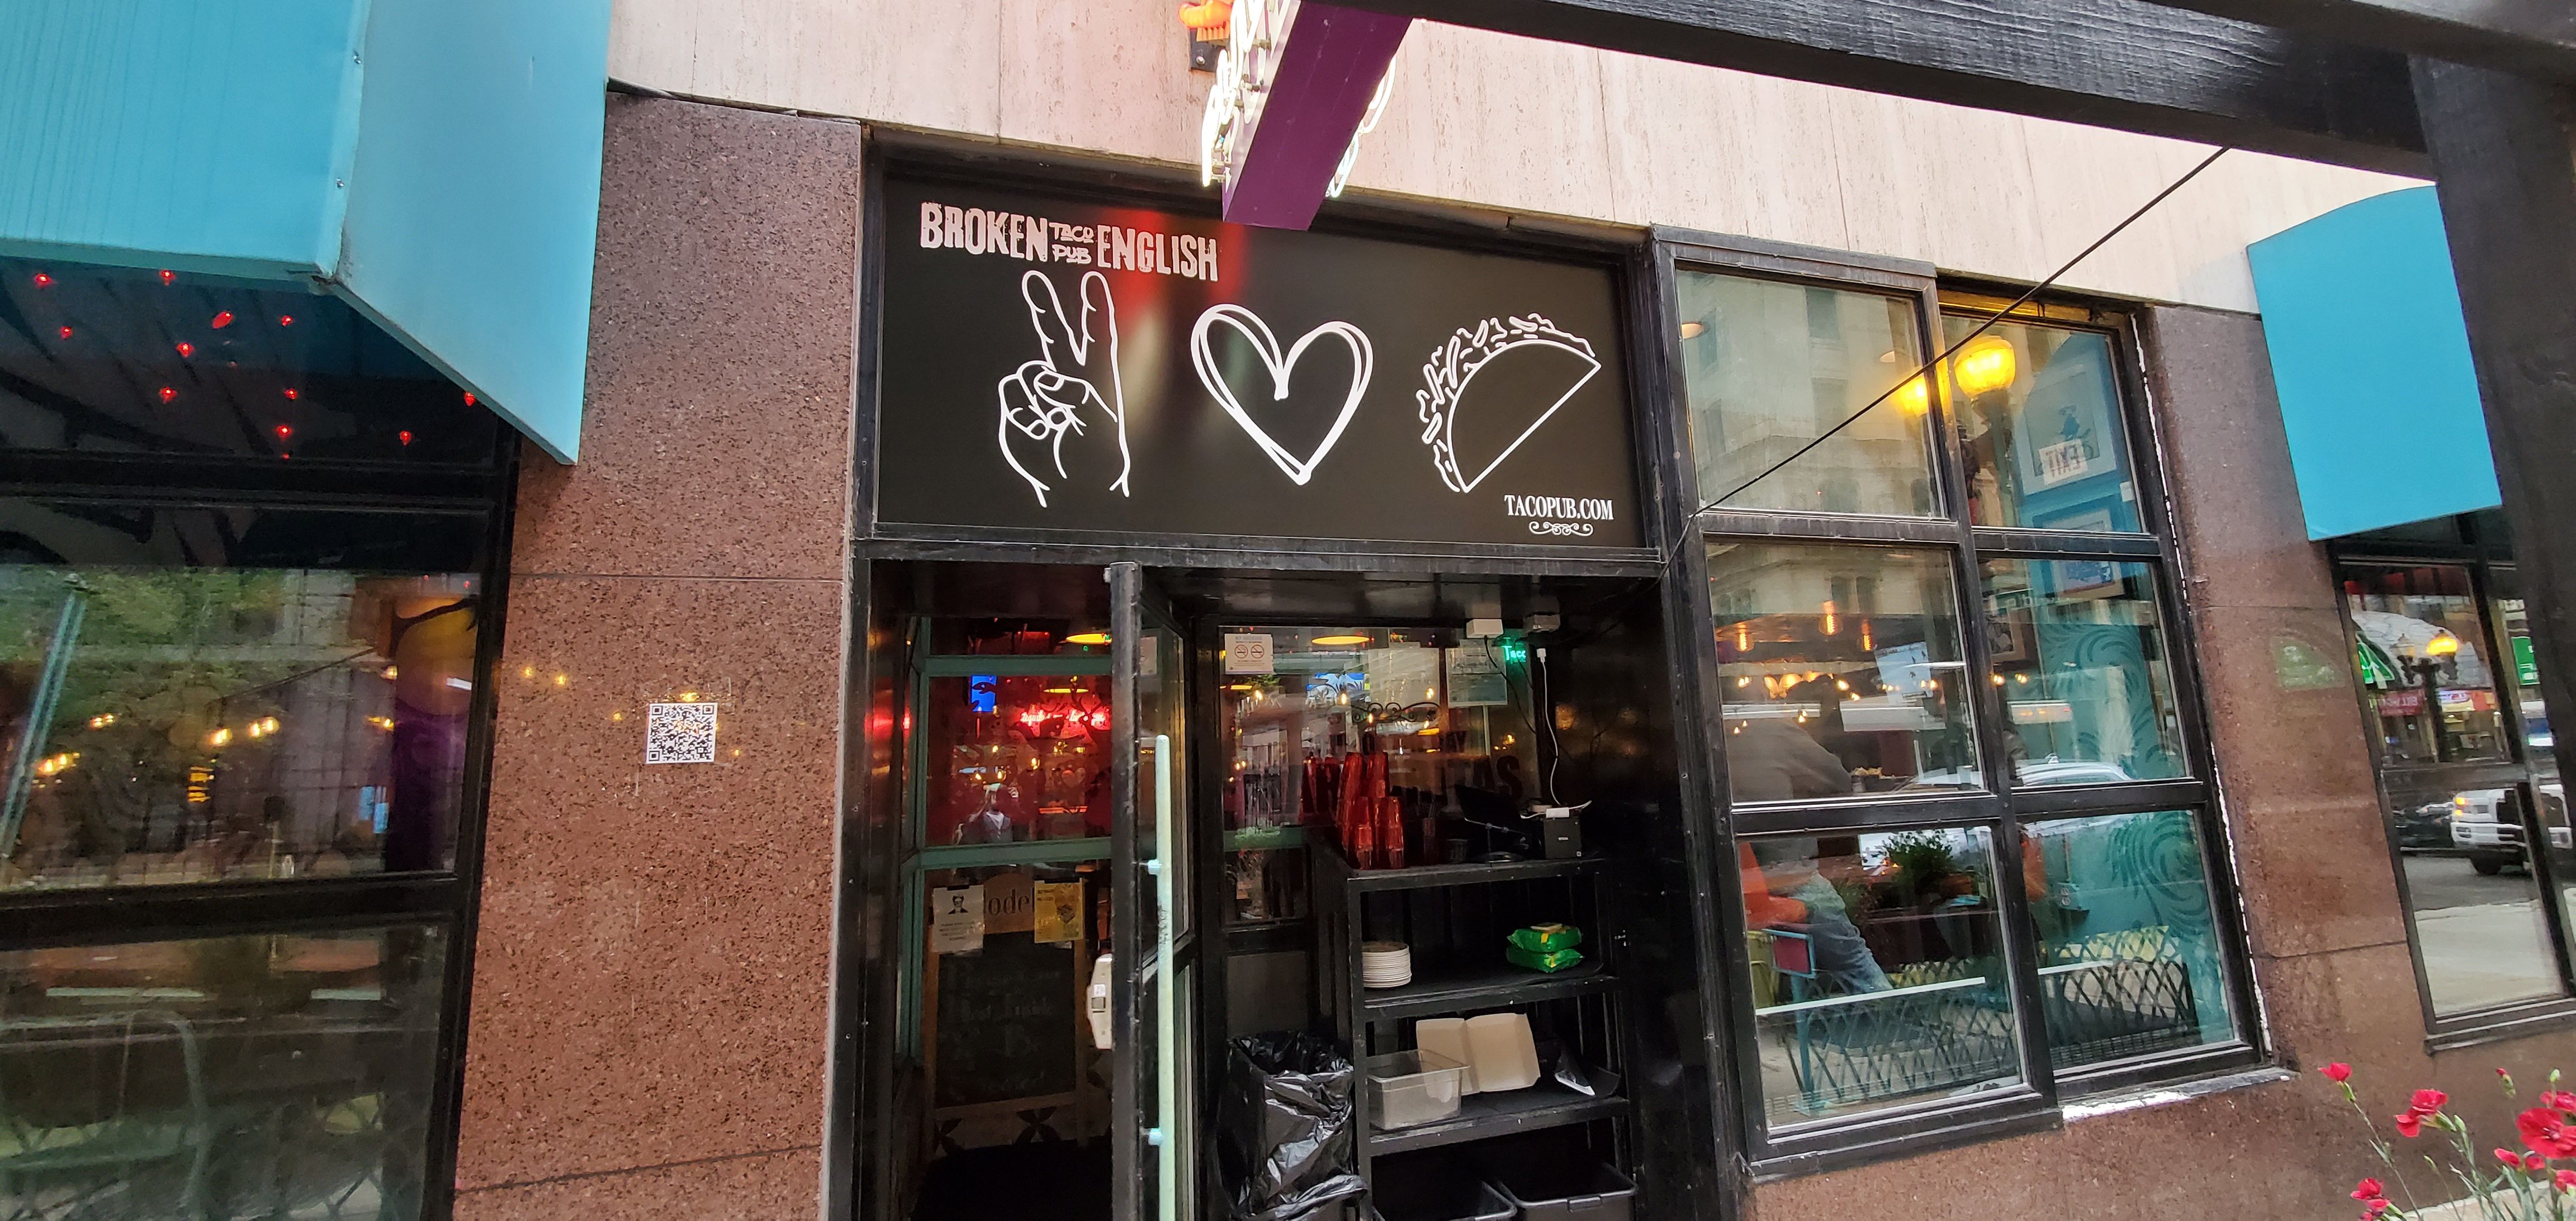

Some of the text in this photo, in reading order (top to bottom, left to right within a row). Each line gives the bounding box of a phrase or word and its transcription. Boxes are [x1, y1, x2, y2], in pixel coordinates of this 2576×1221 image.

[920, 202, 1218, 282] BROKEN ENGLISH
[1049, 222, 1094, 243] TACO
[1052, 244, 1092, 264] PUB
[1504, 495, 1614, 520] TACOPUB.COM
